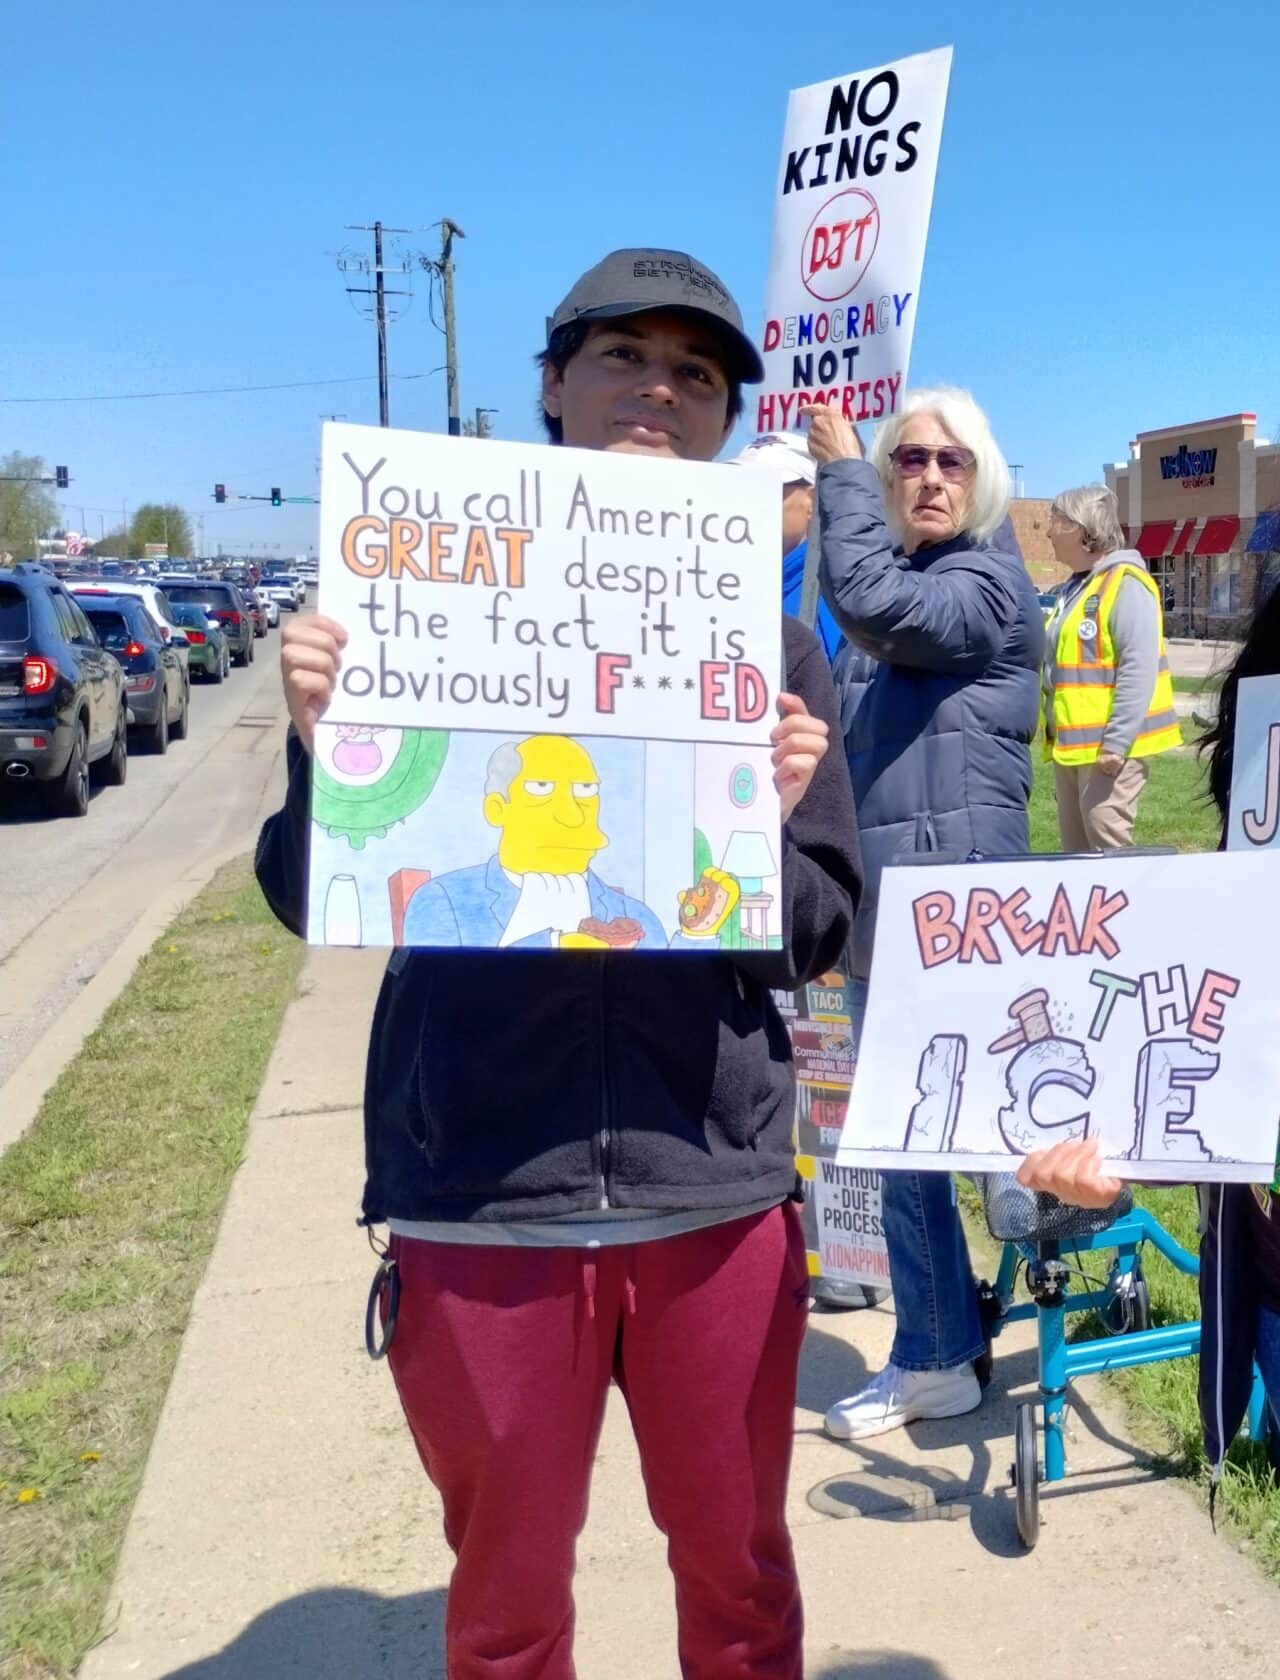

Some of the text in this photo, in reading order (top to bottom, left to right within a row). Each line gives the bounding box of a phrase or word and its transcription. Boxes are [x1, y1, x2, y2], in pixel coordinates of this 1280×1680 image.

[825, 70, 899, 135] NO
[783, 121, 921, 195] KINGS
[809, 217, 872, 273] DJT
[764, 293, 912, 352] DEMOCRACY
[793, 346, 859, 388] NOT
[342, 452, 754, 545] You call America
[341, 515, 741, 607] GREAT despite
[359, 584, 745, 660] the fact it is
[342, 642, 570, 719] obviously
[912, 882, 1128, 969] BREAK
[812, 991, 844, 1010] TACO
[1088, 965, 1240, 1043] THE
[819, 1102, 841, 1125] ICE
[903, 1034, 1220, 1162] ICE
[822, 1162, 880, 1191] WITHOU
[842, 1189, 870, 1211] DUE
[823, 1208, 887, 1237] PROCESS
